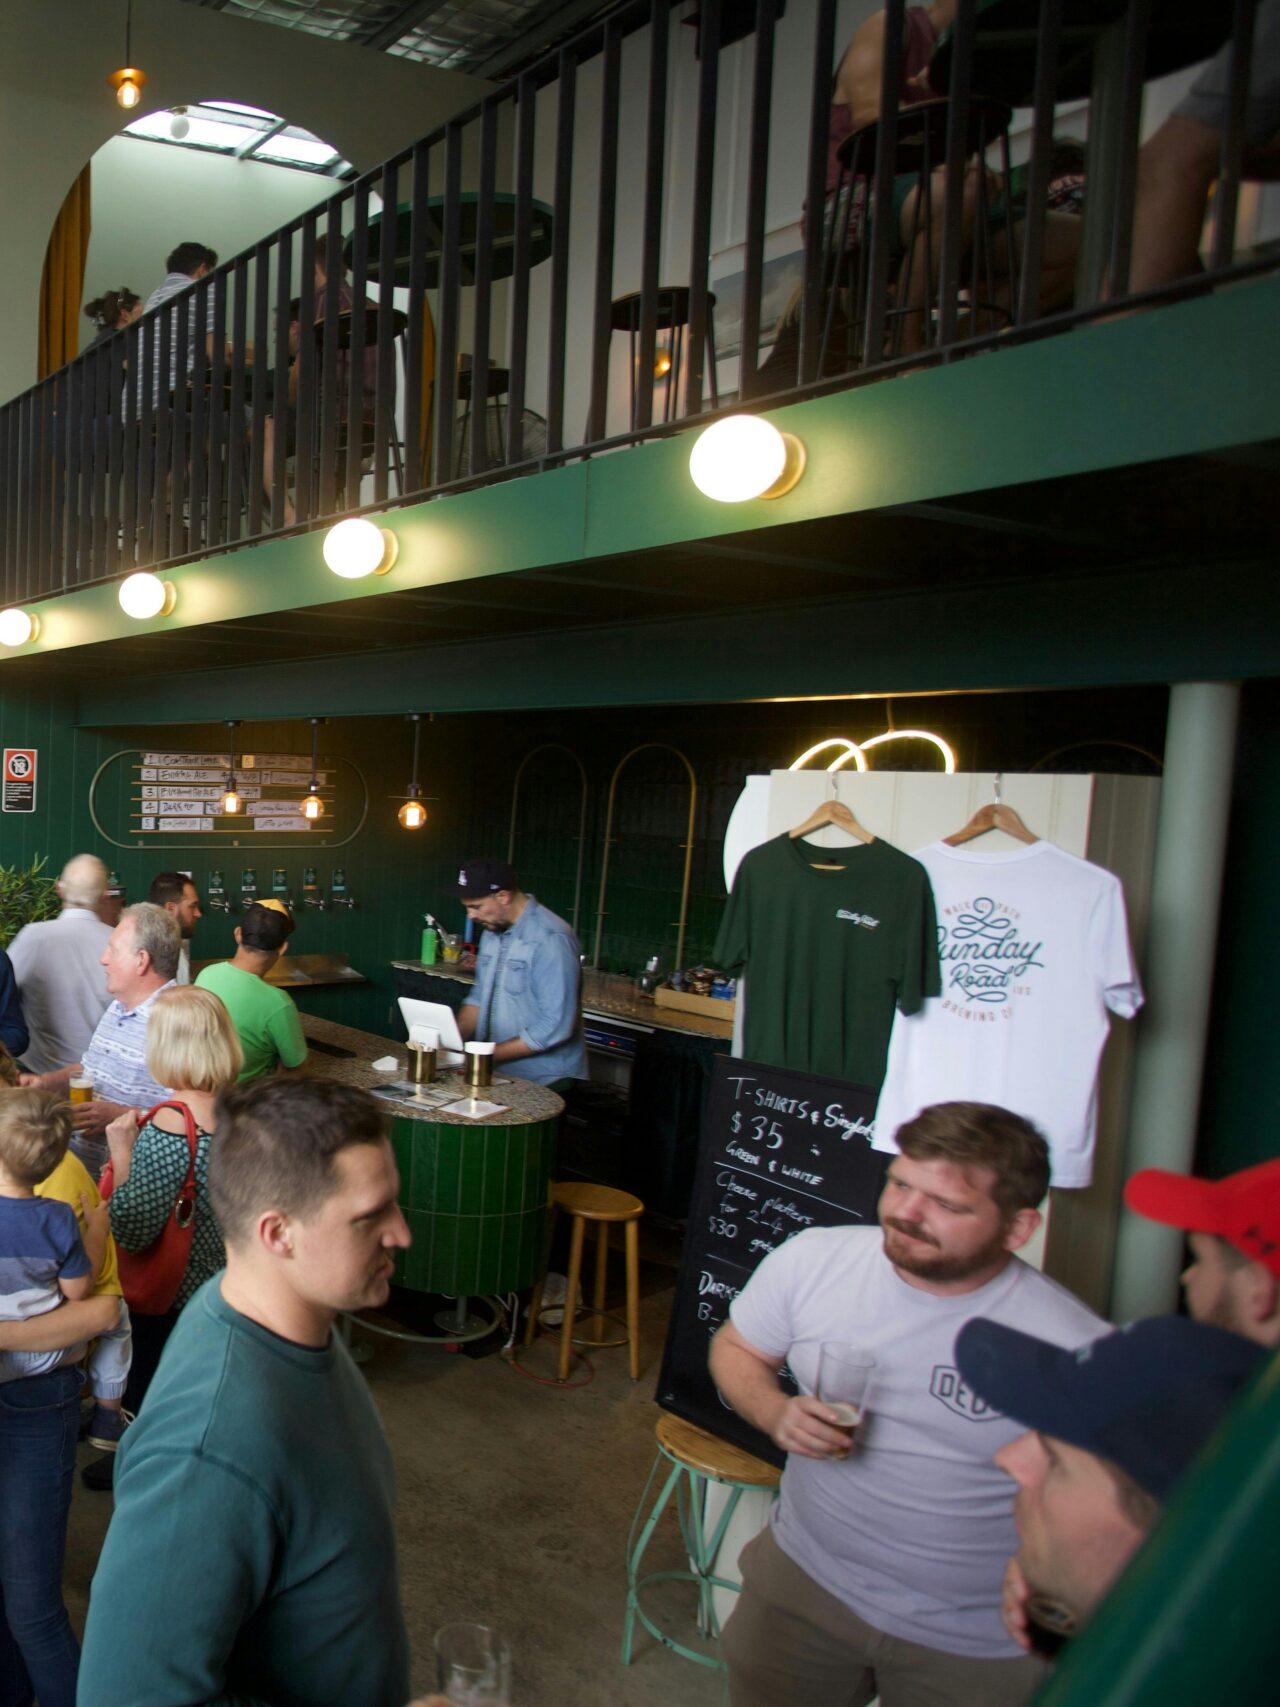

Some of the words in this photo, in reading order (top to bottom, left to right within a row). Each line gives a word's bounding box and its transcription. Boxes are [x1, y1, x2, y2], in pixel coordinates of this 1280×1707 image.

[949, 963, 1016, 1002] Road
[942, 1000, 996, 1021] BREWING
[726, 1077, 810, 1119] T-SHIRTS
[725, 1140, 761, 1166] GREEN
[781, 1164, 825, 1186] WHITE
[715, 1171, 759, 1201] Cheese
[760, 1197, 816, 1226] platters
[708, 1216, 739, 1239] $30
[746, 1209, 784, 1236] 2-4
